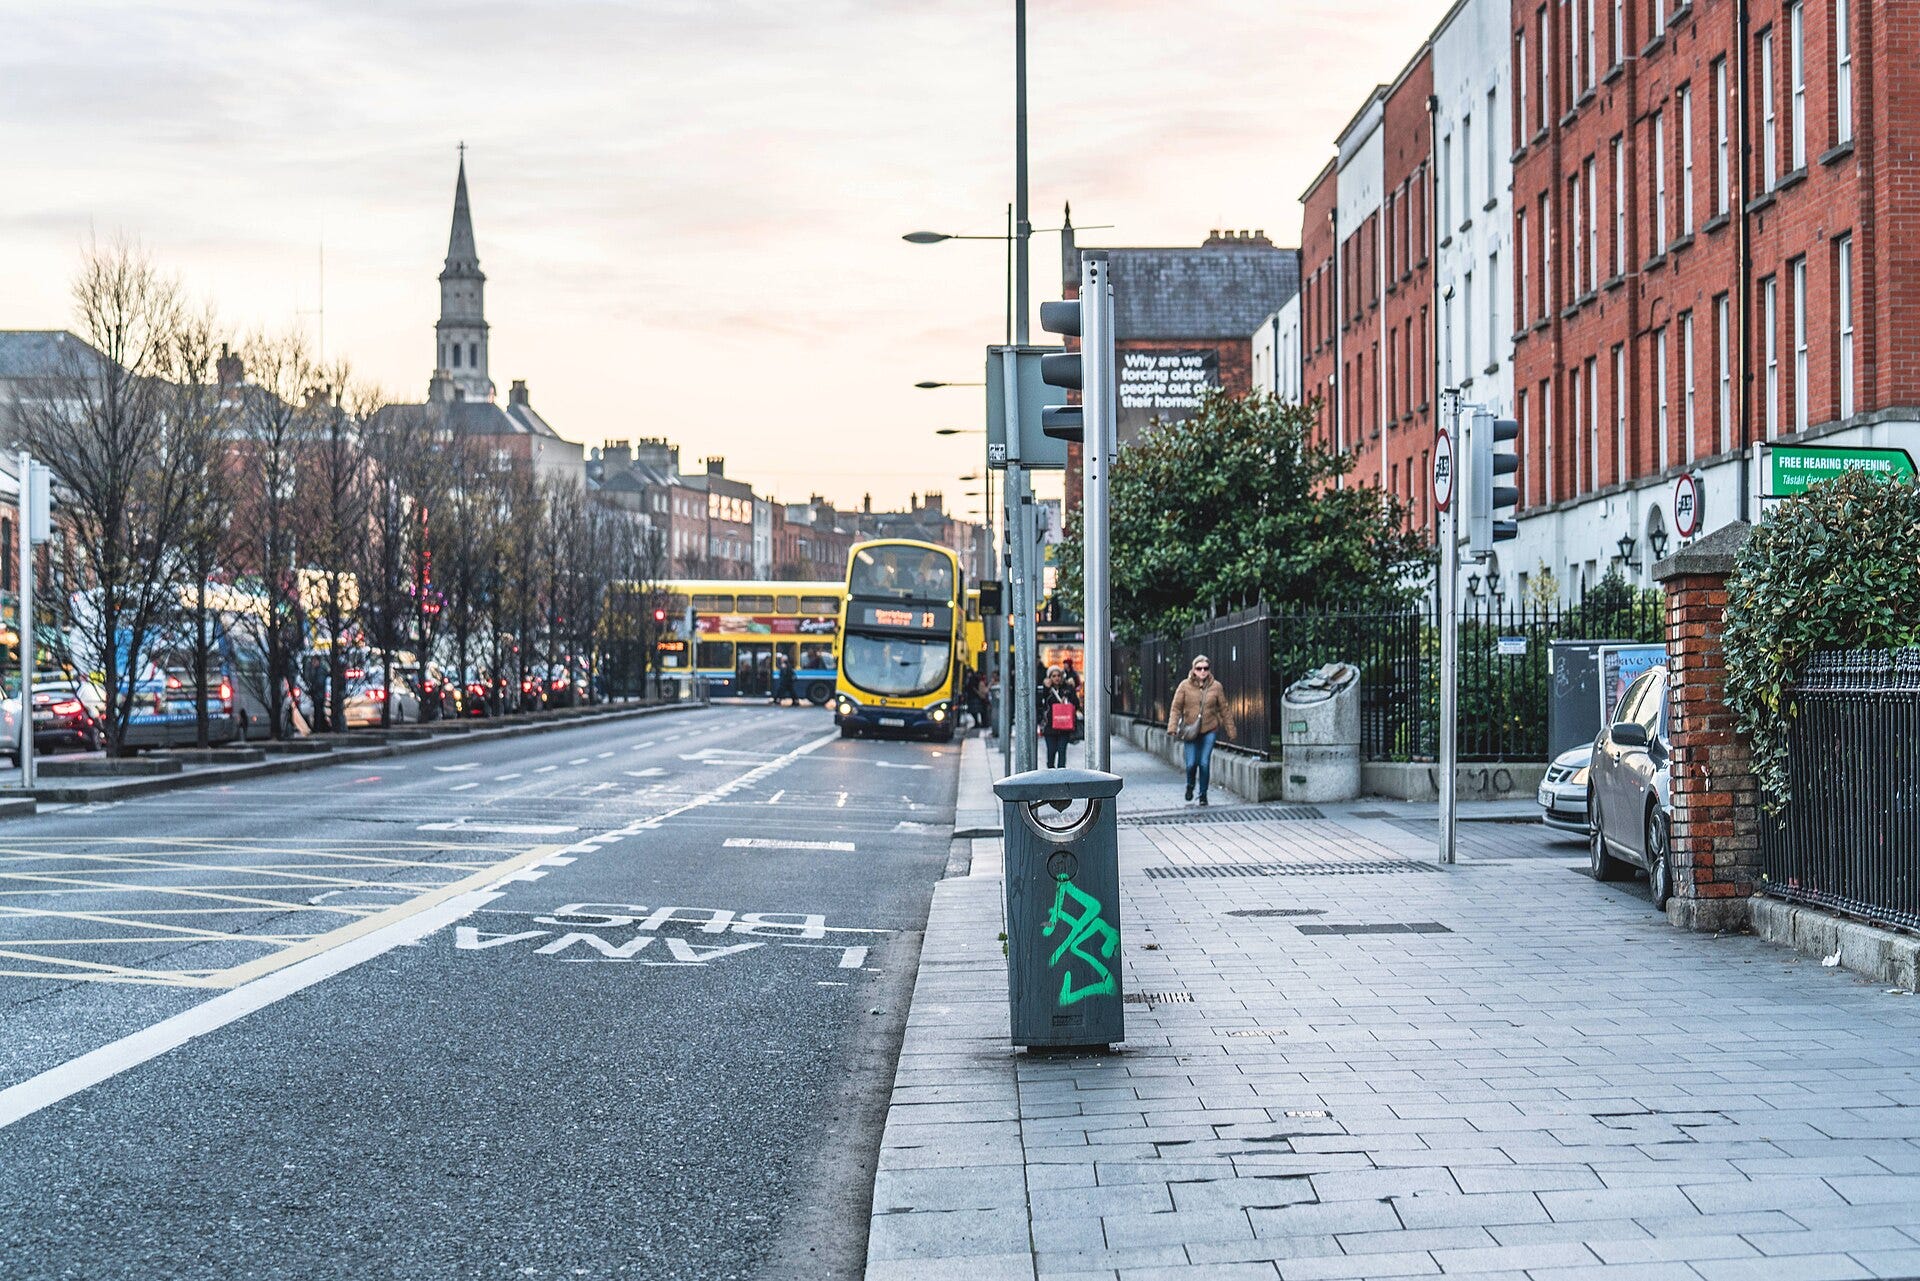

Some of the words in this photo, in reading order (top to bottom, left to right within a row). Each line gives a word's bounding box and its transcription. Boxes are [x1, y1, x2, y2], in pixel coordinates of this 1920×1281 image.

[1124, 354, 1157, 370] Why
[1158, 356, 1180, 367] are
[1181, 356, 1203, 367] we
[1121, 367, 1168, 383] forcing
[1170, 367, 1206, 381] older
[1120, 381, 1167, 397] people
[1168, 382, 1192, 394] out
[1122, 395, 1154, 408] their
[1779, 456, 1802, 469] FREE
[1803, 457, 1842, 470] HEARING
[1843, 458, 1891, 471] SCREENING
[1617, 656, 1643, 666] ave
[532, 903, 827, 940] BUS
